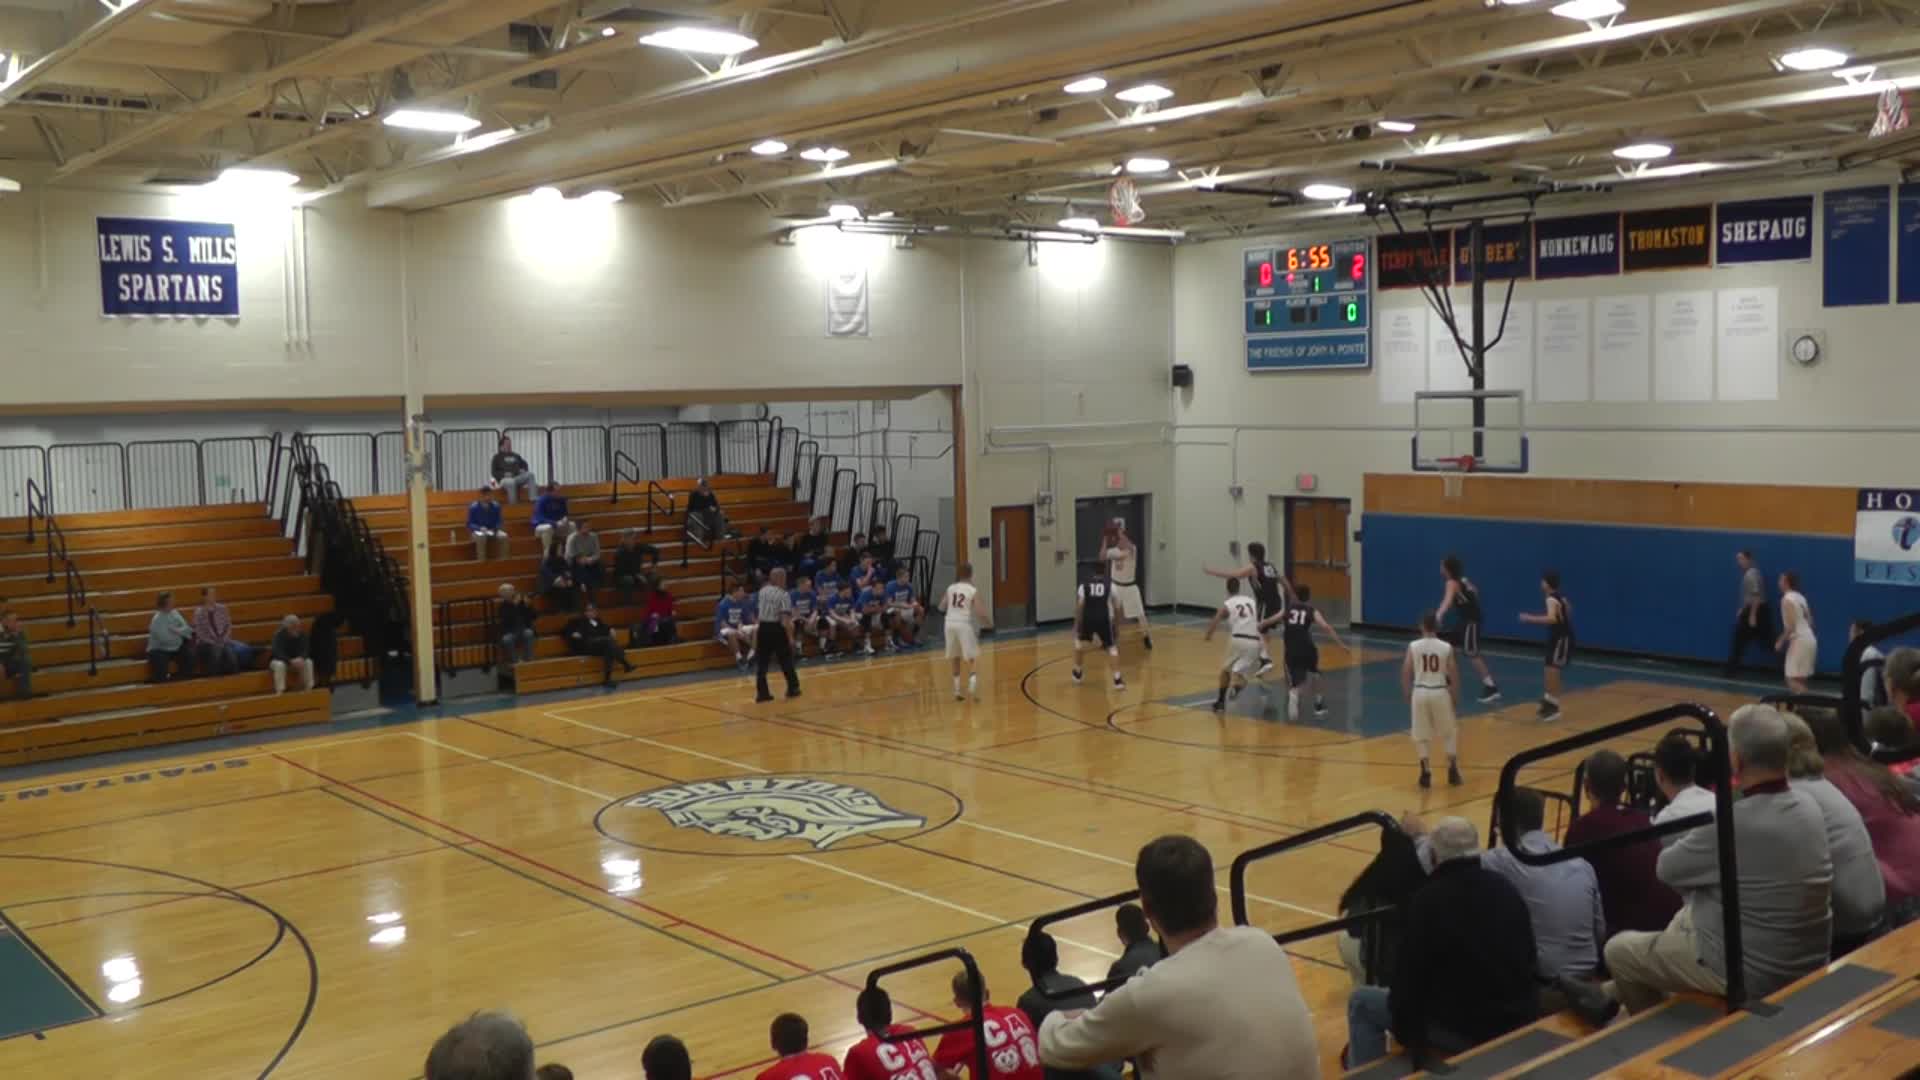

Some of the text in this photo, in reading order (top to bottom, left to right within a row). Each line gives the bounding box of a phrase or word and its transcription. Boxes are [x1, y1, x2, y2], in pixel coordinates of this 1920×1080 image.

[1629, 225, 1705, 251] THOMASTON
[1722, 217, 1806, 244] SHEPAUG
[100, 234, 236, 264] LEWIS S. MILLS
[1287, 245, 1330, 271] 6:55
[1539, 234, 1615, 258] NONNEWAUG
[1259, 262, 1273, 287] 0
[1352, 253, 1365, 280] 2
[117, 273, 223, 302] SPARTANS
[1313, 276, 1320, 292] 1
[1265, 303, 1357, 325] 1 0
[953, 592, 966, 608] 12
[1089, 583, 1105, 597] 10
[1288, 608, 1307, 625] 31
[1422, 649, 1440, 673] 10
